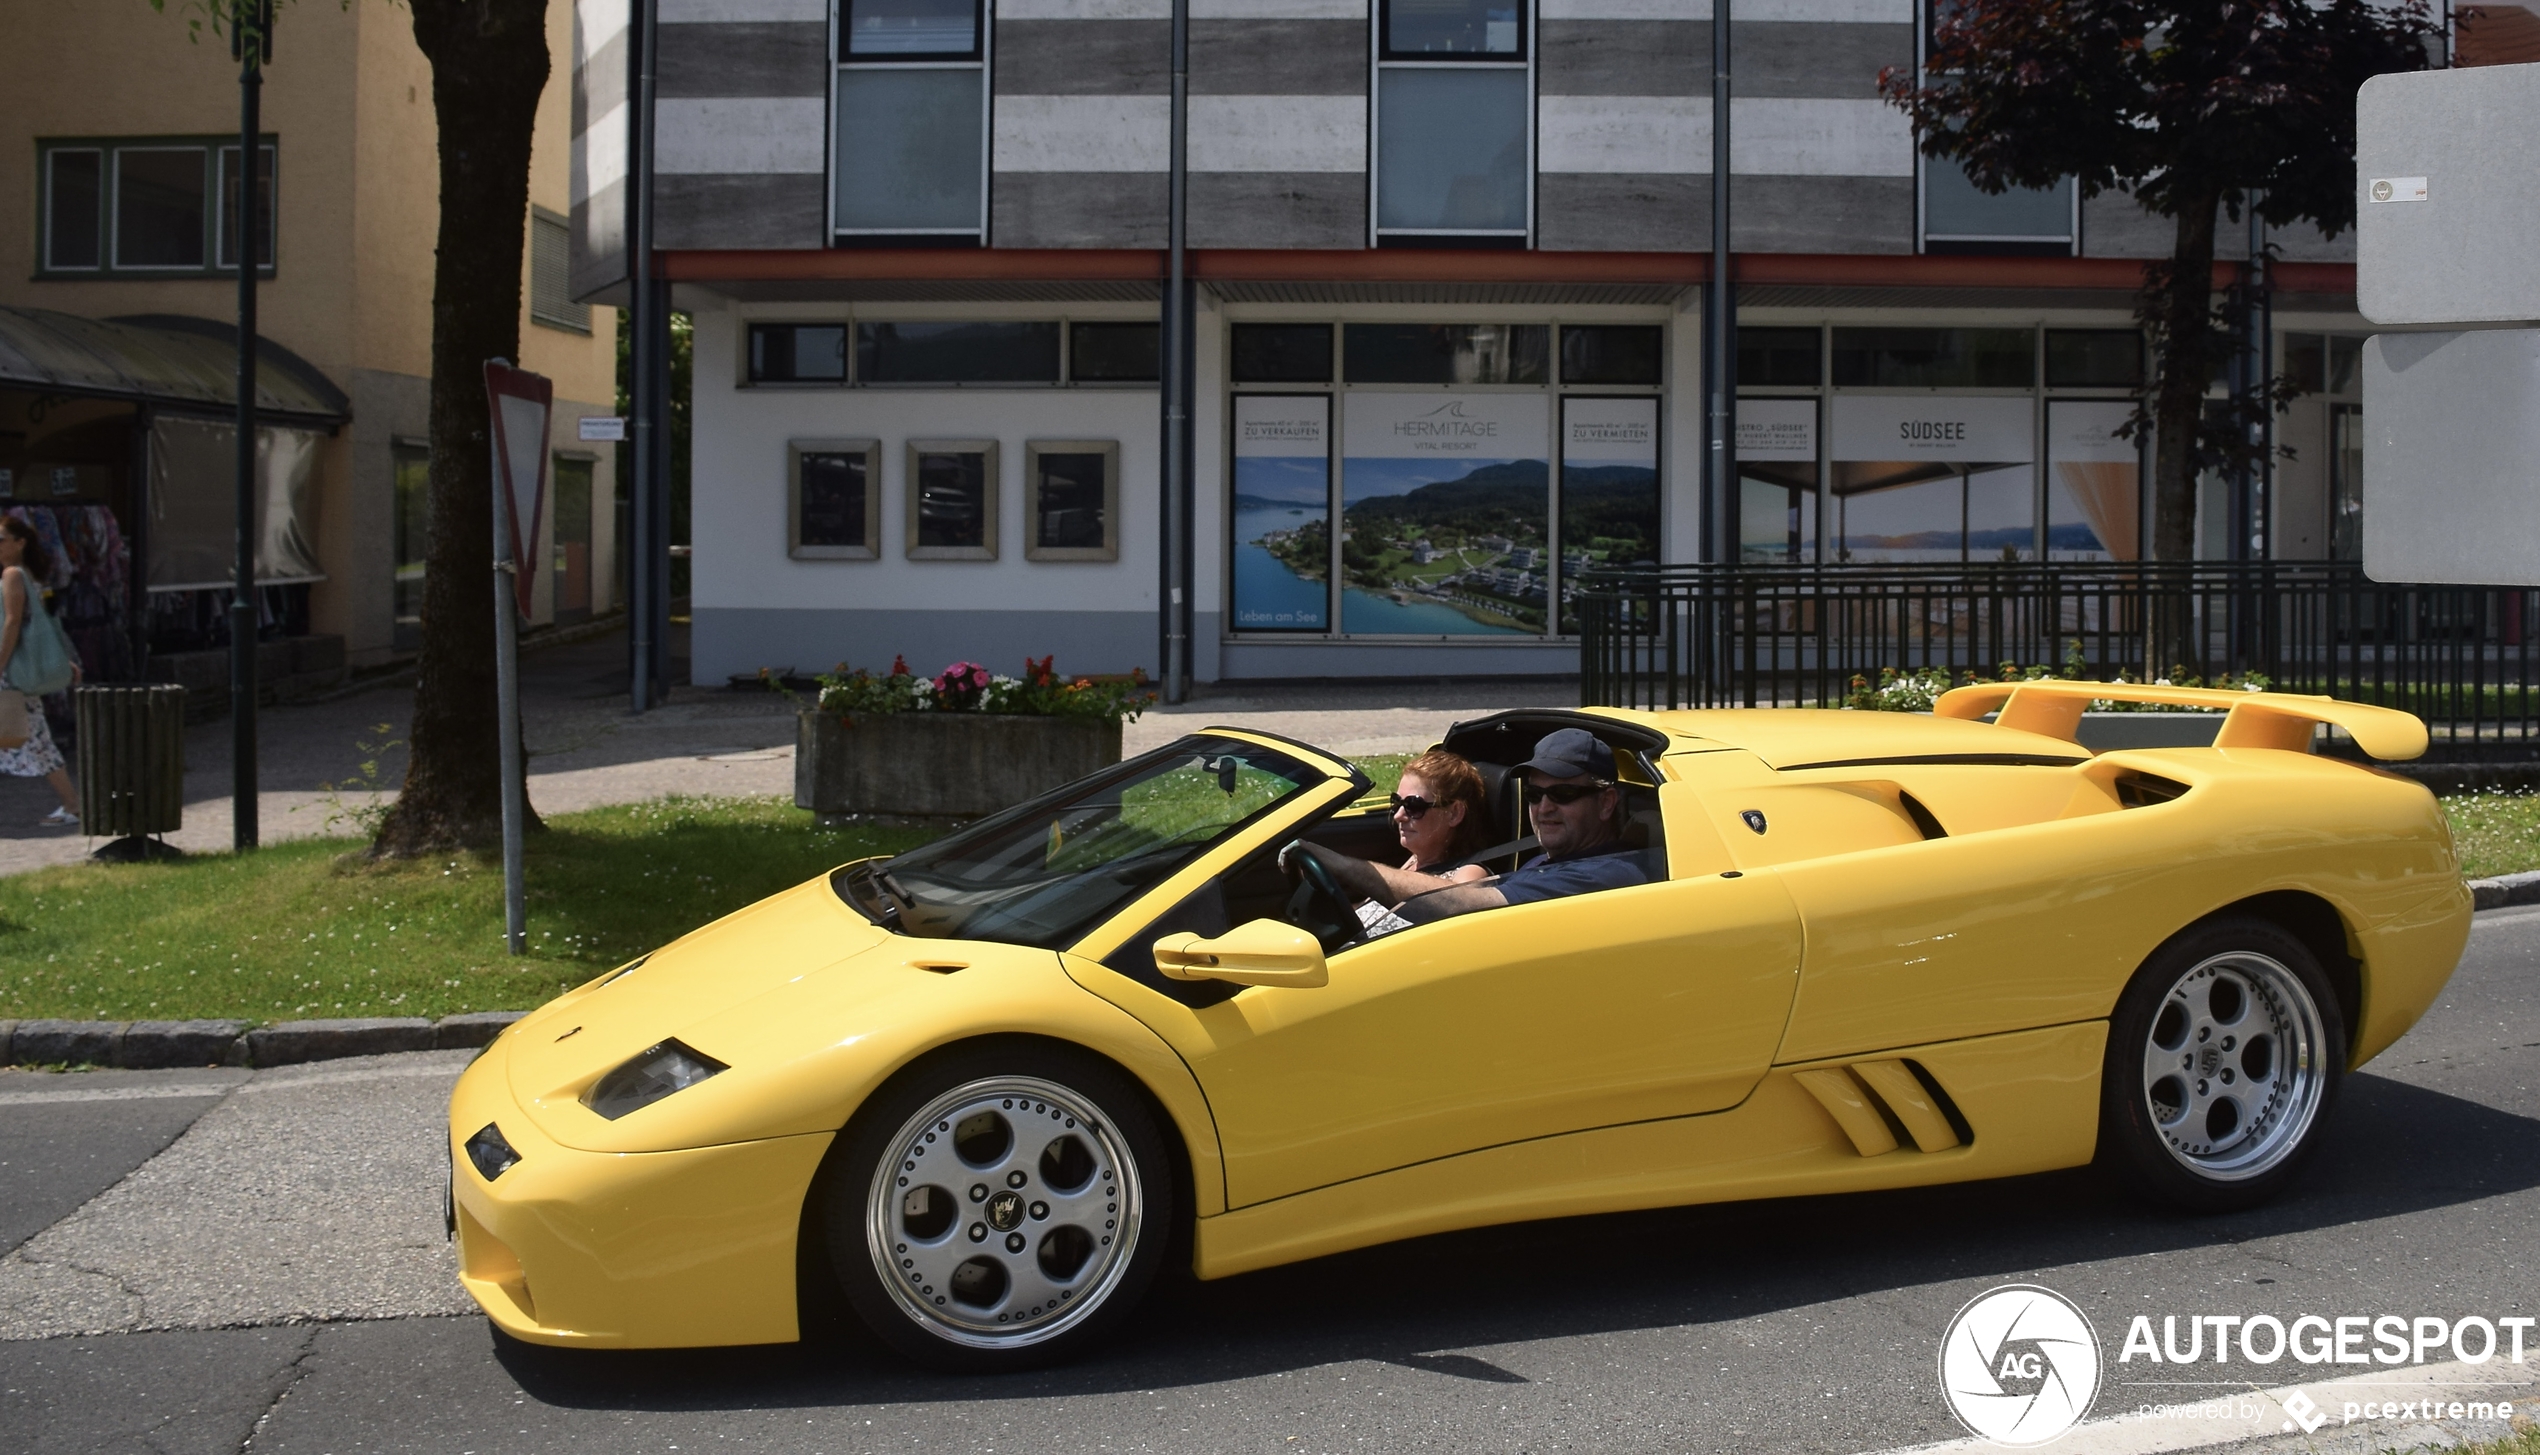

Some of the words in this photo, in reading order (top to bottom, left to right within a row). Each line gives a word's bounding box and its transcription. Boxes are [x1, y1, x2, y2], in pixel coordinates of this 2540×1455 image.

[1245, 427, 1258, 435] ZU
[1261, 427, 1320, 435] VERKAUFEN
[1393, 421, 1498, 437] HERMITAGE
[1735, 423, 1763, 431] ISTRO
[1900, 419, 1966, 440] SÜDSEE
[1573, 430, 1586, 438] ZU
[1590, 430, 1649, 438] VERMIETEN
[1414, 442, 1439, 450] VITAL
[1441, 442, 1477, 450] RESORT
[1239, 609, 1273, 622] Leben
[1274, 612, 1294, 622] am
[1295, 610, 1318, 622] See
